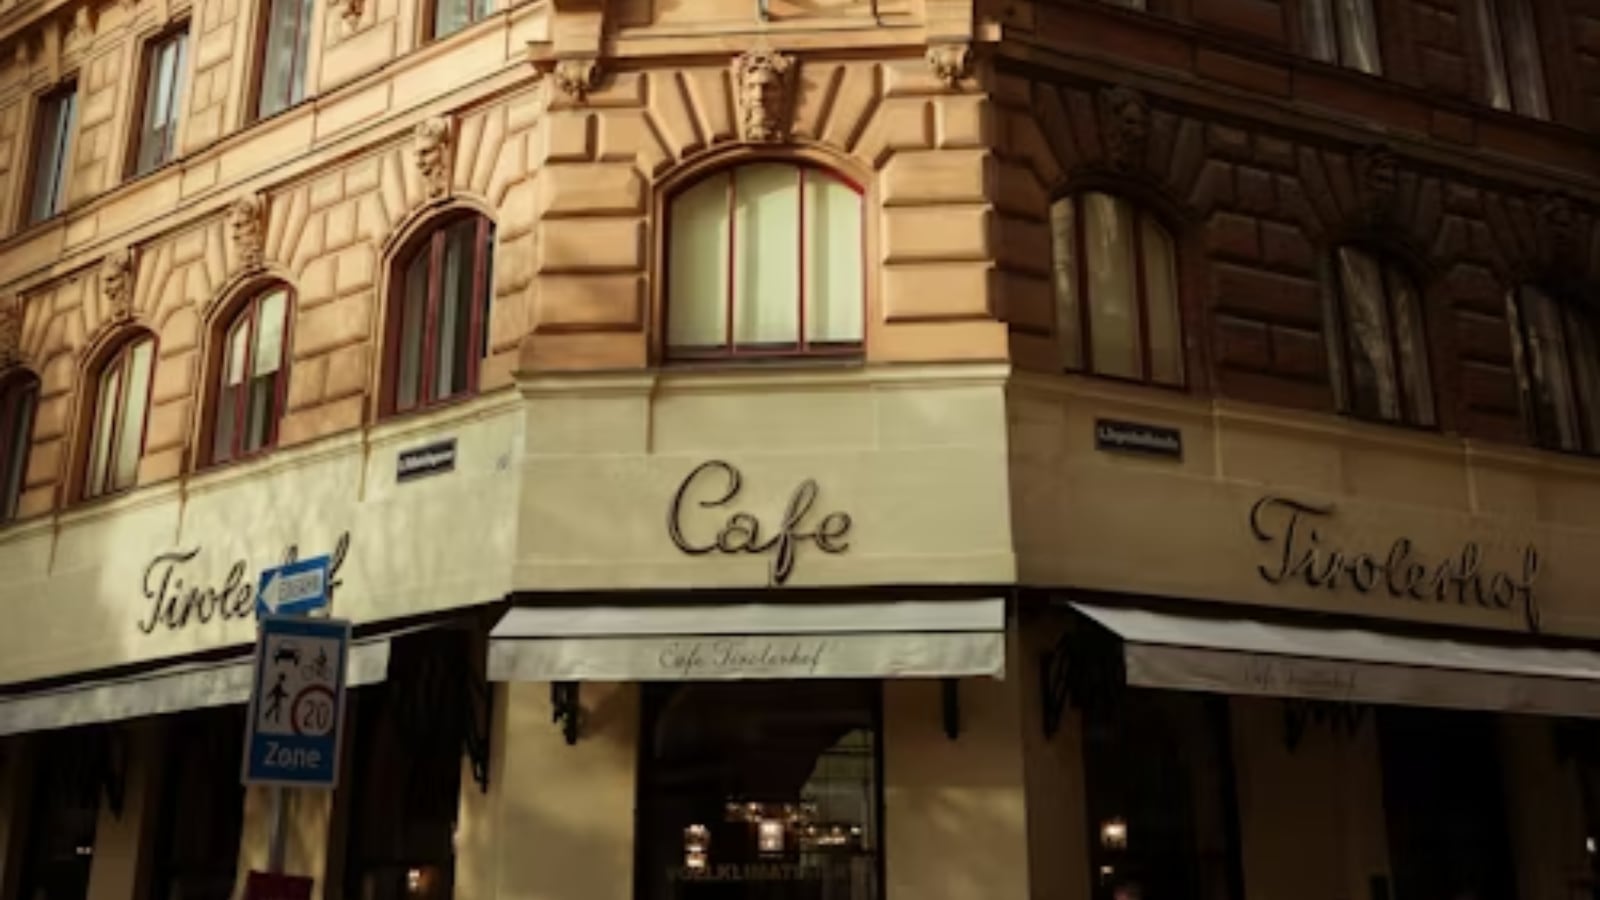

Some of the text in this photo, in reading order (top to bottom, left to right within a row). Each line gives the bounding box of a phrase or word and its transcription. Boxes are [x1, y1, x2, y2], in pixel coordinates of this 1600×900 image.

[667, 460, 851, 585] Cafe
[1250, 496, 1540, 633] Tirolerhof
[138, 531, 350, 634] Tirolef
[263, 742, 322, 768] Zone
[303, 701, 329, 731] 20
